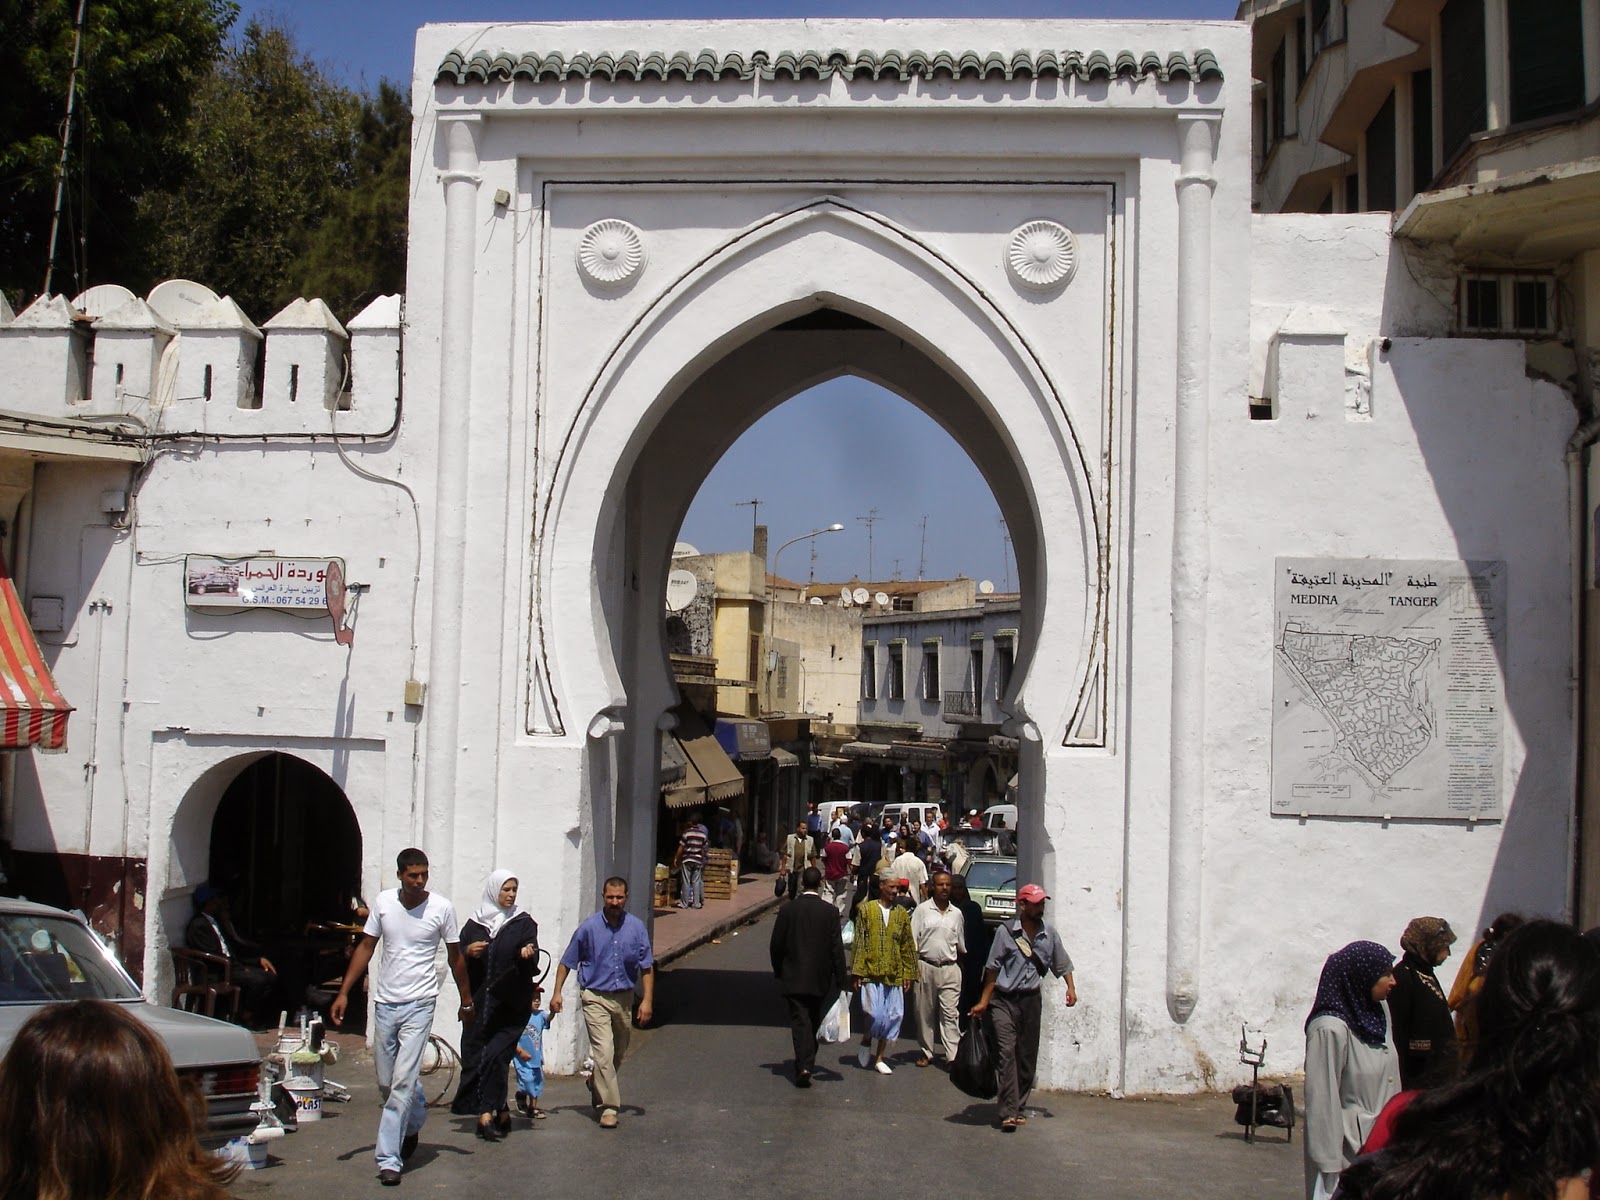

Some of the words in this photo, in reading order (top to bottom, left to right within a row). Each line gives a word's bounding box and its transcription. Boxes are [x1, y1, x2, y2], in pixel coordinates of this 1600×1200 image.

[288, 562, 327, 583] وردة
[1407, 574, 1438, 589] طنجة
[276, 596, 292, 604] 067
[295, 597, 306, 605] 54
[308, 597, 320, 605] 29
[1290, 594, 1338, 605] MEDINA
[1389, 596, 1438, 607] TANGER
